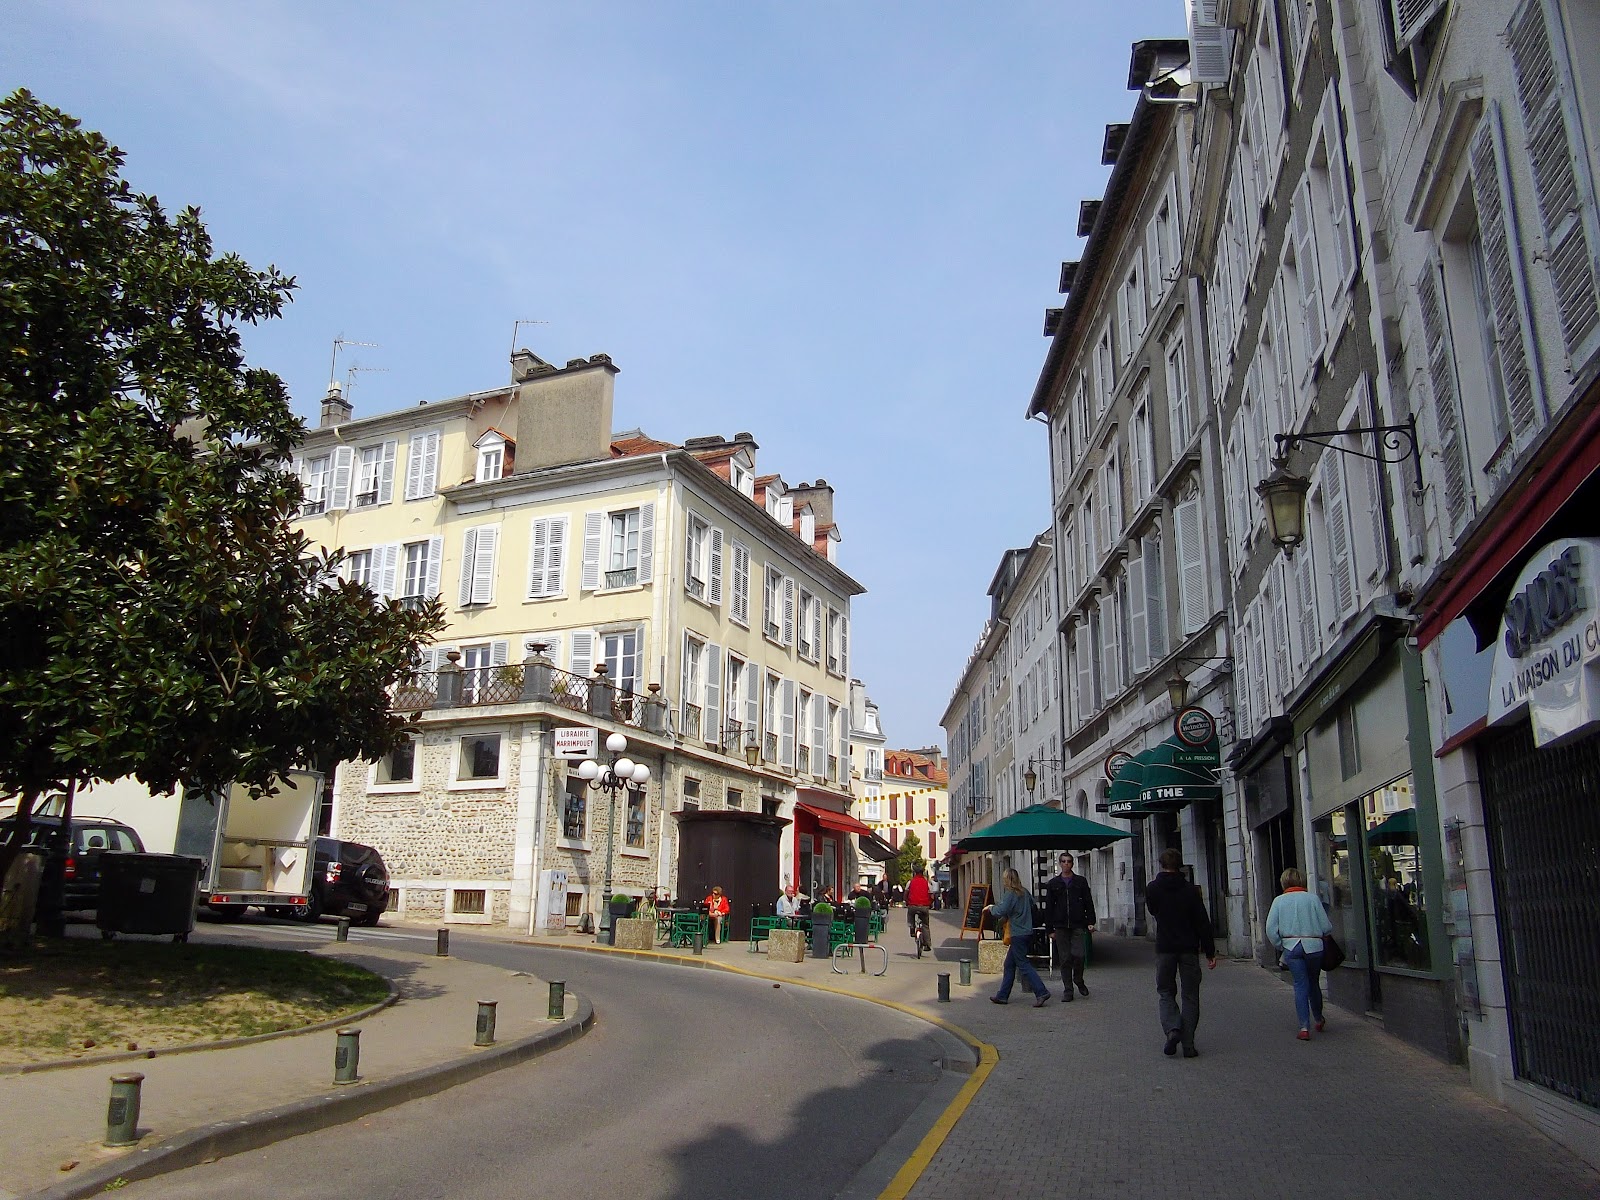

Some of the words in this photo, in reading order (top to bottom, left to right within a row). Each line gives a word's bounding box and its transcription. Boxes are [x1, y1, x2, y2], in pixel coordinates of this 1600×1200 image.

[1502, 682, 1516, 708] LA
[1517, 649, 1560, 698] MAISON
[1562, 634, 1581, 668] DU
[1182, 722, 1210, 731] Heineken
[1143, 791, 1151, 800] DE
[1157, 788, 1183, 798] THE
[1111, 802, 1132, 812] PALAIS
